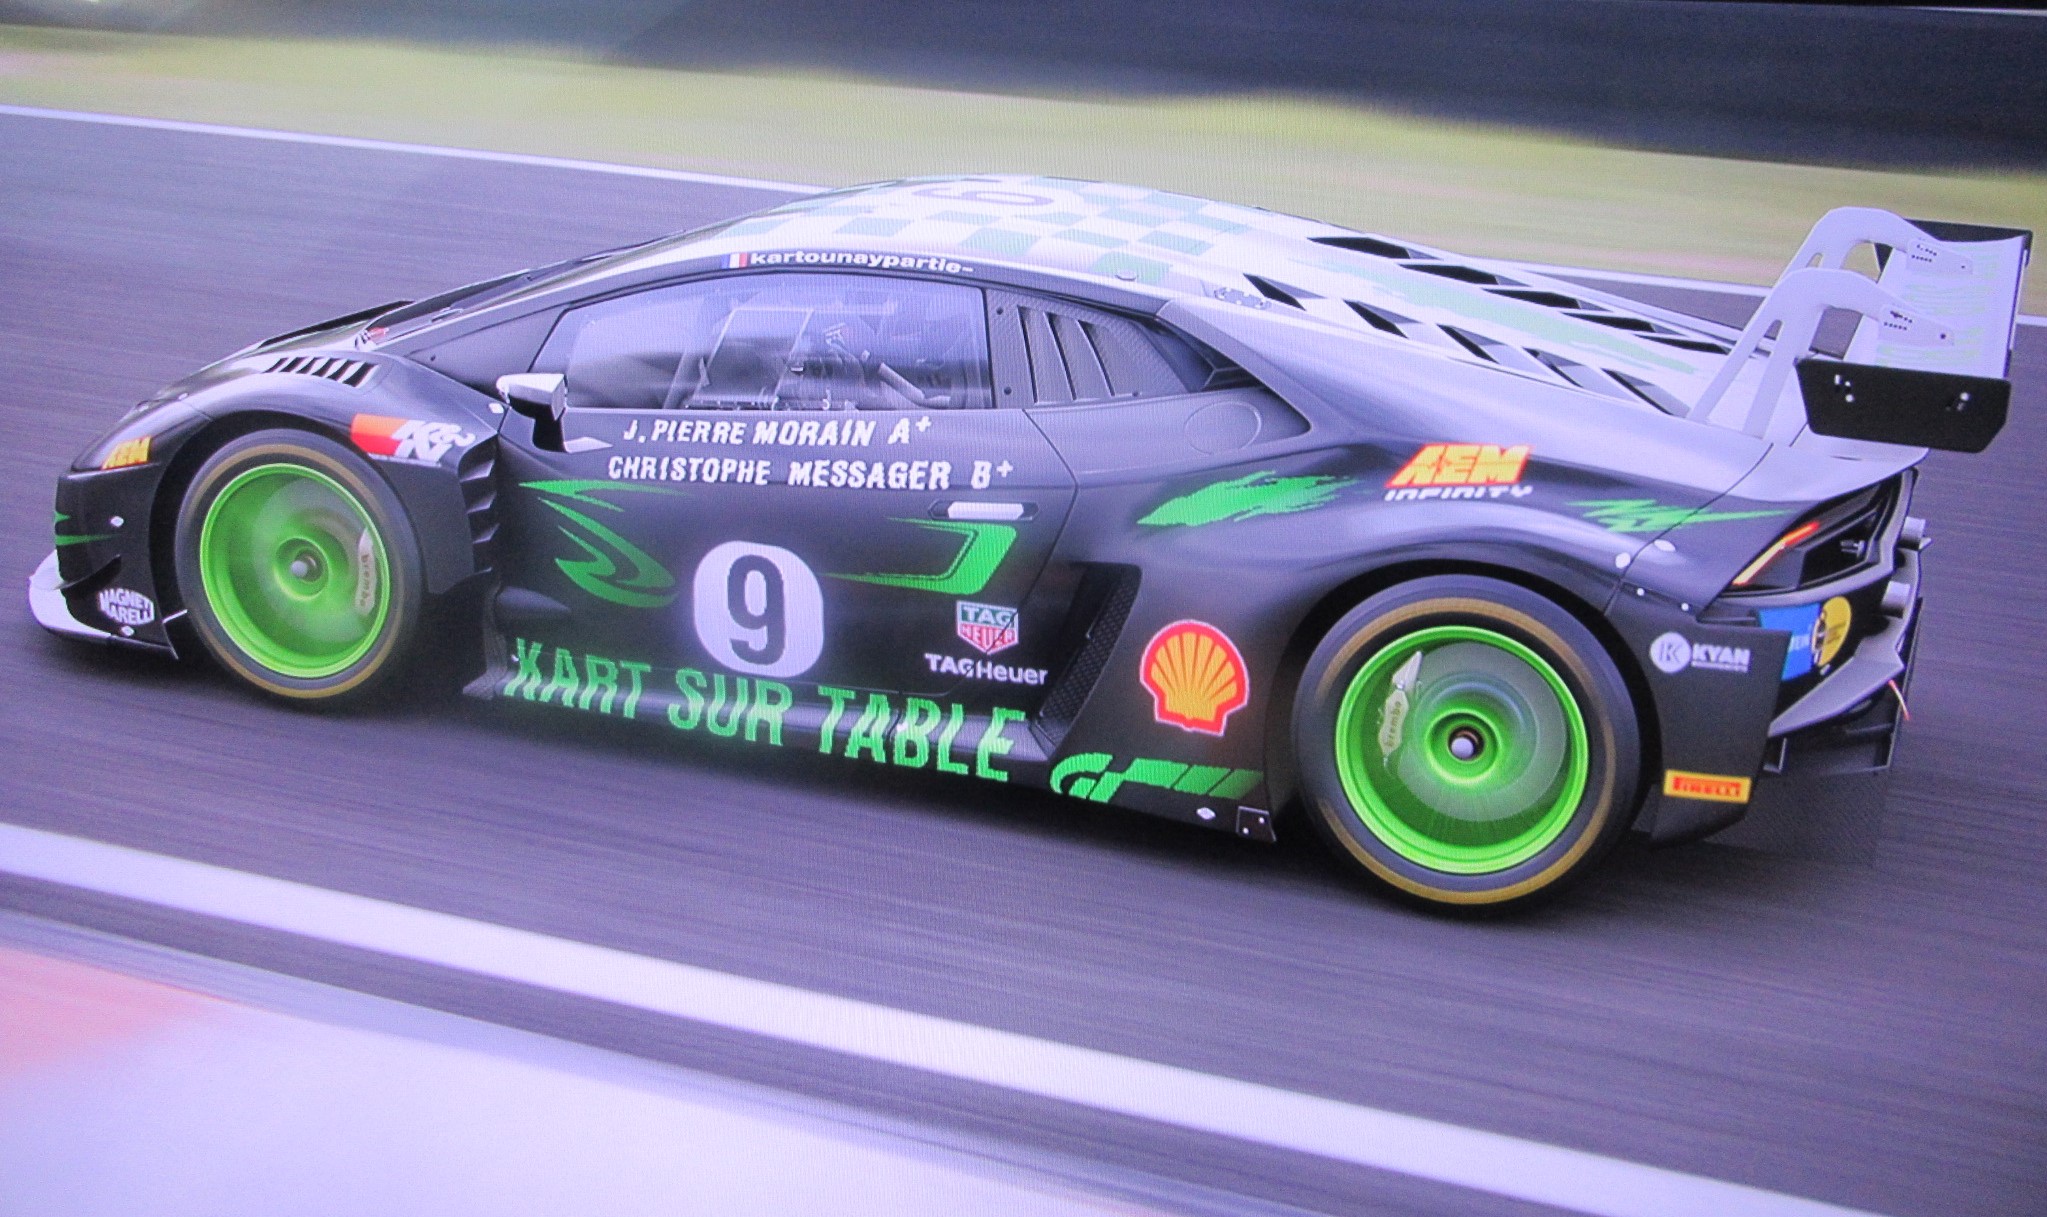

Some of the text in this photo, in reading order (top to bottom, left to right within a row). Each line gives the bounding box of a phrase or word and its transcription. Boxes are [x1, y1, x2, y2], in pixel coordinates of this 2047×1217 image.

[753, 419, 877, 446] MORAIN
[608, 456, 771, 486] CHRISTOPHE
[788, 459, 951, 491] MESSAGER
[1386, 442, 1534, 488] AEM
[727, 554, 786, 666] 9
[962, 606, 1014, 628] TAG
[503, 637, 1027, 783] KART SUR TABLE
